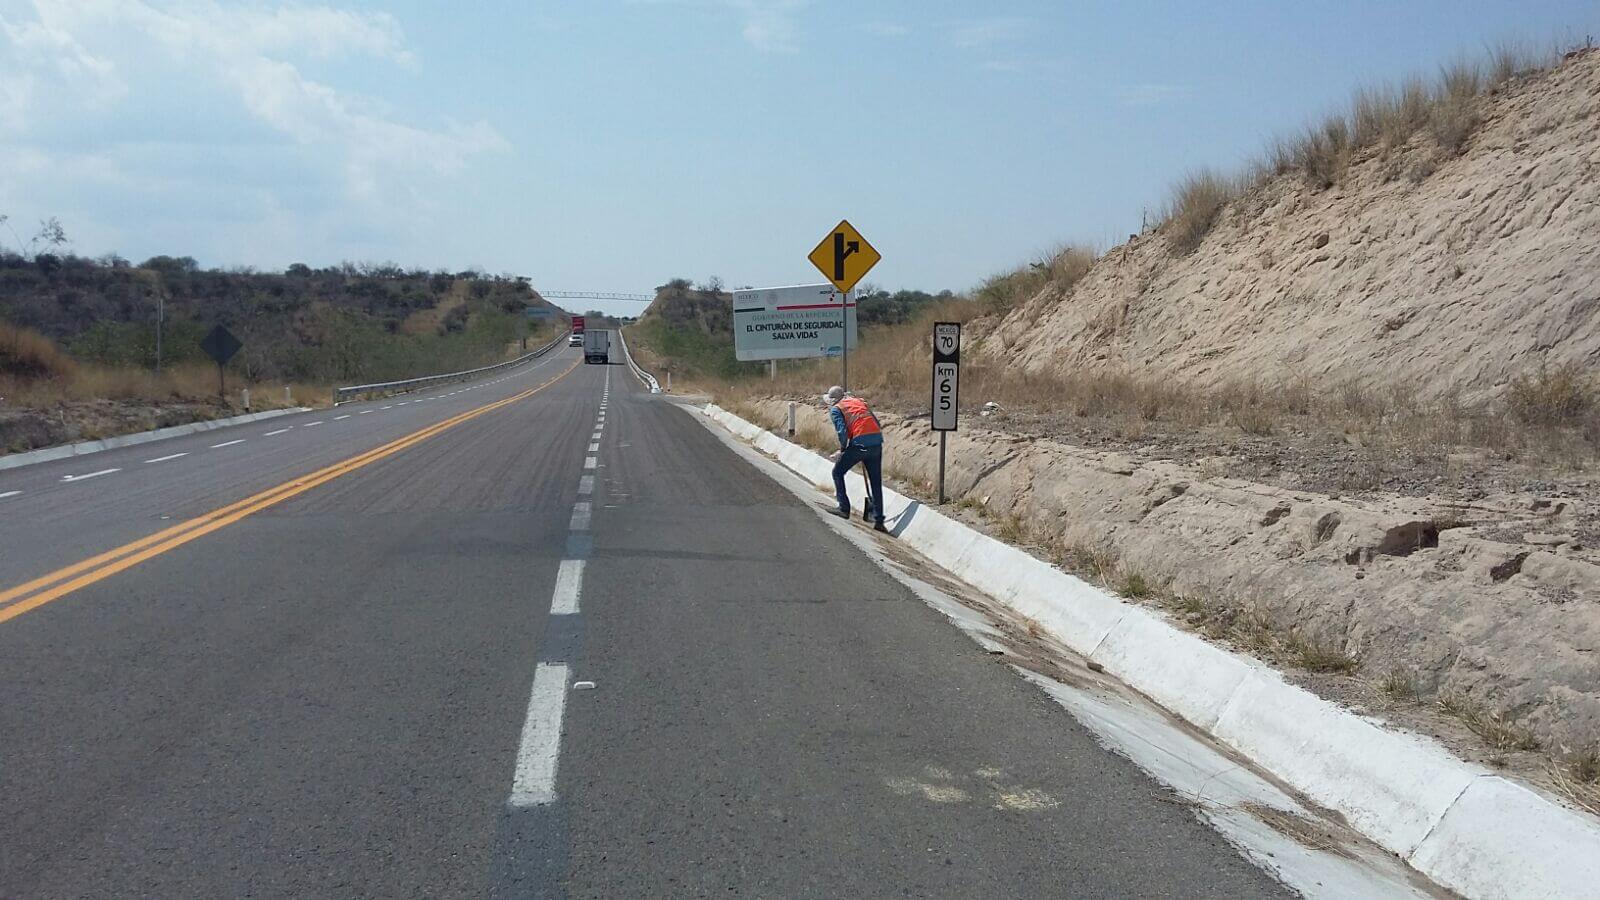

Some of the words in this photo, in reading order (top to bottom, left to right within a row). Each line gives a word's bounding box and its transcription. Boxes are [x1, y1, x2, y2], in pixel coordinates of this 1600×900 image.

[746, 325, 754, 333] EL
[793, 322, 803, 330] DE
[772, 331, 795, 340] SALVA
[796, 330, 818, 339] VIDAS
[940, 336, 953, 348] 70
[937, 366, 954, 376] km
